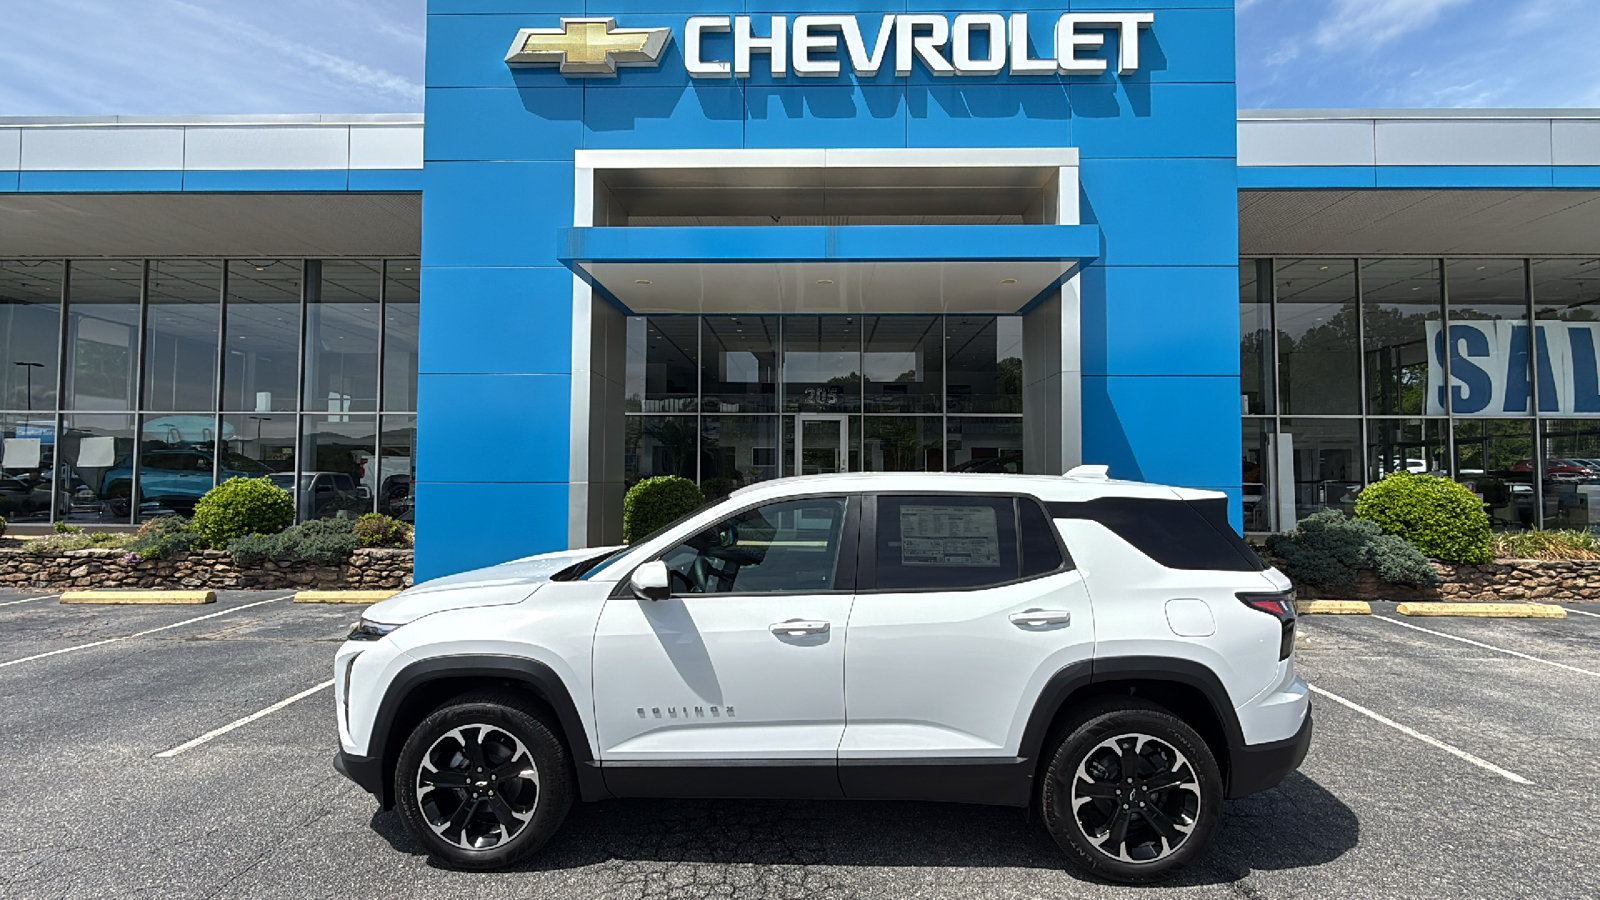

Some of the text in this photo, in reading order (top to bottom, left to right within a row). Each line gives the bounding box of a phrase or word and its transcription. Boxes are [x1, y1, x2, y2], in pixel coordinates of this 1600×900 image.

[685, 12, 1154, 78] CHEVROLET
[804, 387, 838, 404] 205
[636, 706, 735, 716] EQUINOX
